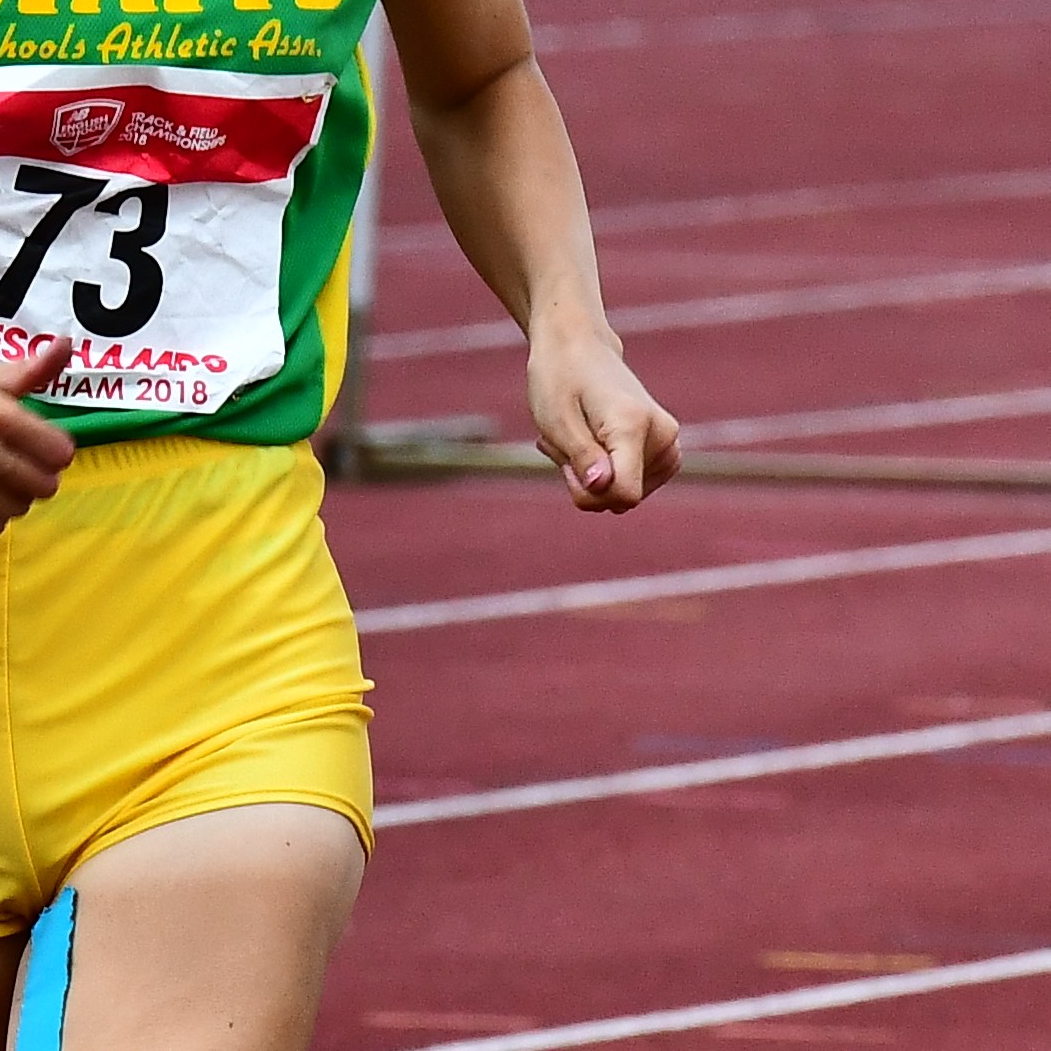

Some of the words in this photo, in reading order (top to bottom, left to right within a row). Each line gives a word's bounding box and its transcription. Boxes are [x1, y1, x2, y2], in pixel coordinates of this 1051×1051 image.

[97, 23, 236, 64] Athletic
[247, 18, 323, 58] Assn.
[118, 132, 148, 146] 2018
[132, 112, 175, 132] TRACK
[176, 124, 187, 137] &
[189, 126, 219, 140] FIELD
[136, 377, 209, 406] 2018
